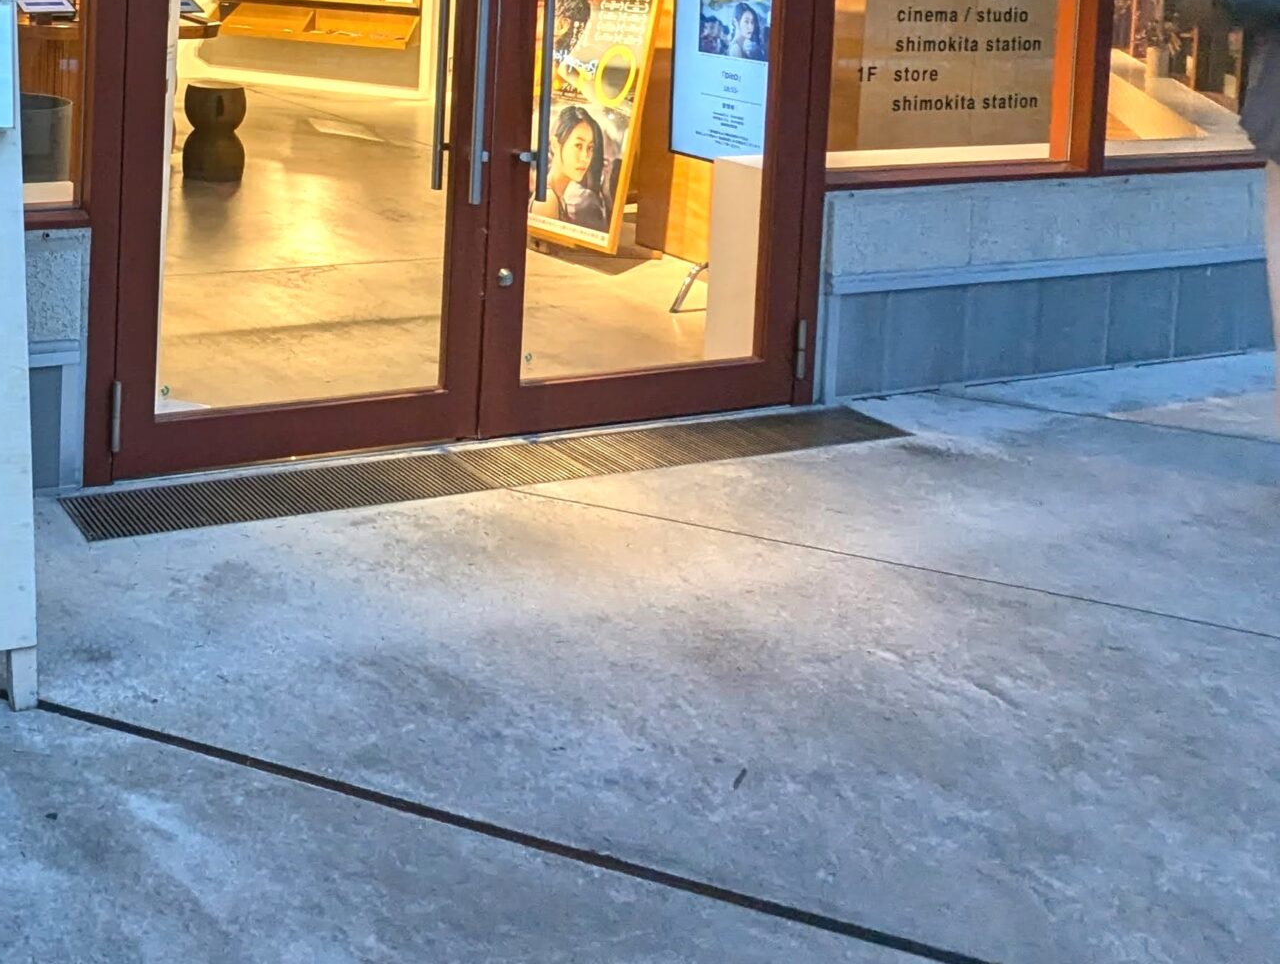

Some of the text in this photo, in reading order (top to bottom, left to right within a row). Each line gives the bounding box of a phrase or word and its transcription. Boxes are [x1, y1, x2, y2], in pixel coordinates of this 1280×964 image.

[897, 6, 958, 23] cinema
[977, 7, 1028, 23] studio
[895, 36, 1041, 53] shimokita station
[857, 66, 938, 82] 1F store
[892, 93, 1038, 112] shimokita station
